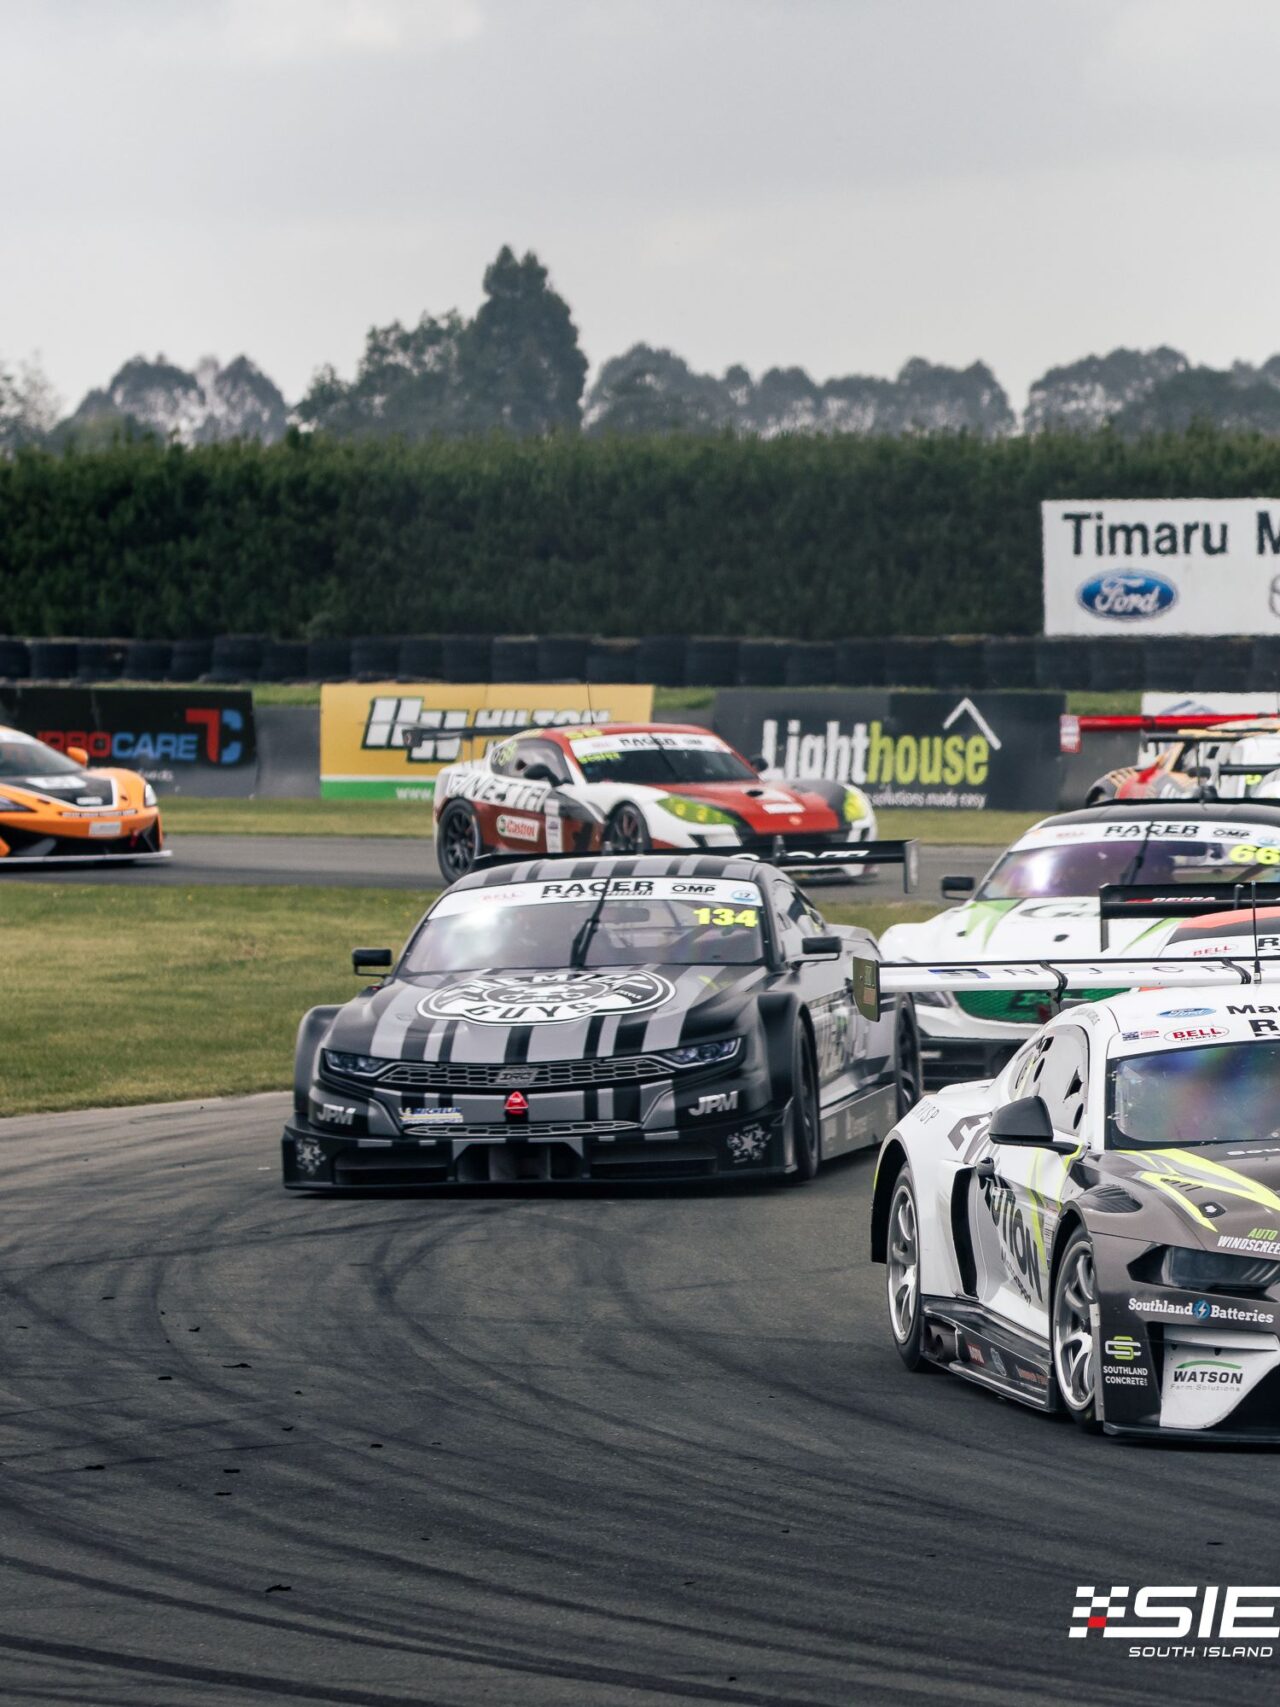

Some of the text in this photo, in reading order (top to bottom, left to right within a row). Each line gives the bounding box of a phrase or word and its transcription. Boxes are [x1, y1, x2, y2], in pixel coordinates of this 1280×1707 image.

[1062, 511, 1228, 556] Timaru
[1094, 576, 1160, 613] Ford
[759, 719, 990, 786] Lighthouse
[1104, 825, 1200, 837] RACER
[1213, 829, 1250, 838] OMP
[1229, 844, 1280, 865] 66
[541, 881, 654, 895] RACER
[672, 884, 716, 894] OMP
[693, 907, 758, 927] 134
[1192, 945, 1231, 956] BELL
[464, 1003, 599, 1019] GUYS
[1172, 1028, 1221, 1039] BELL
[688, 1090, 739, 1116] JPM
[316, 1103, 357, 1125] JPM
[1248, 1227, 1279, 1241] AUTO
[1128, 1297, 1274, 1324] Southland Batteries
[1103, 1365, 1148, 1376] SOUTHLAND
[1173, 1370, 1243, 1384] WATSON
[1104, 1375, 1144, 1386] CONCRETE
[1196, 1384, 1241, 1392] Solutions
